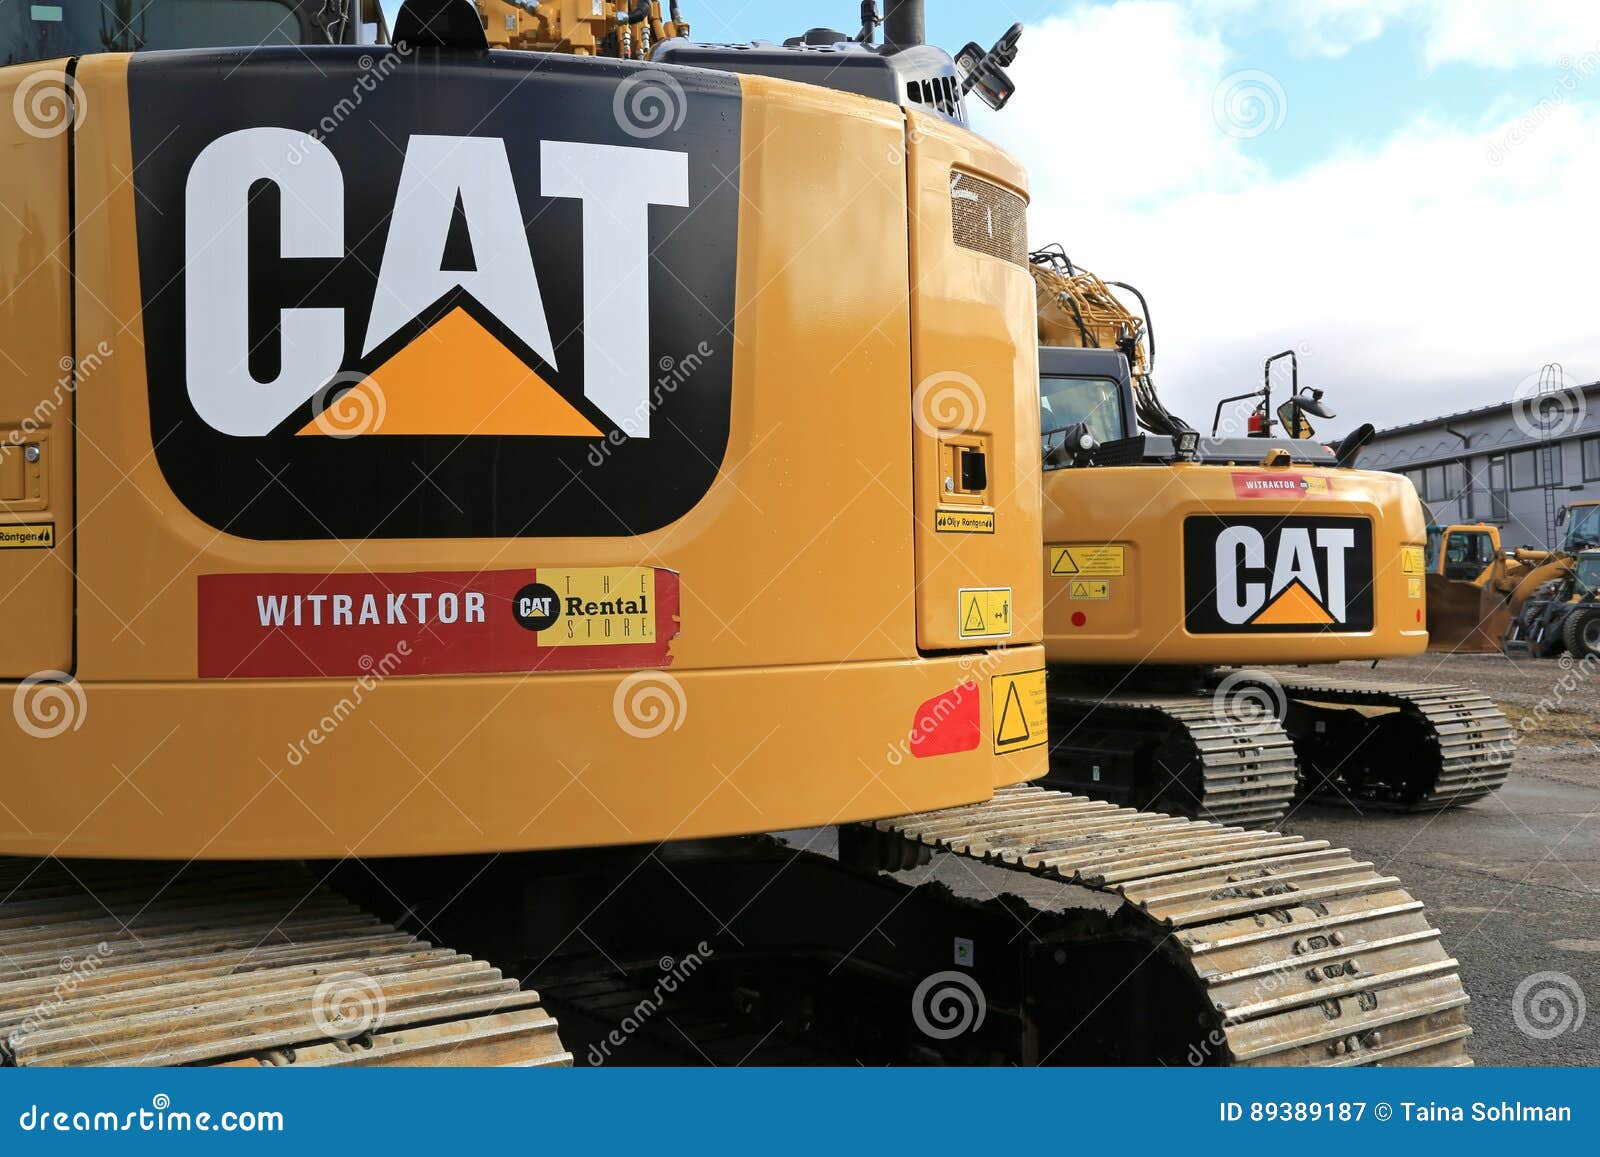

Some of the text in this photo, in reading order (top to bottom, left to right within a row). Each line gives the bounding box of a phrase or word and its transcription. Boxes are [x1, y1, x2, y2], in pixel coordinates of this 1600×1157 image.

[185, 126, 689, 439] CAT
[1246, 480, 1295, 489] WITRAKTOR
[565, 575, 646, 595] THE
[1215, 525, 1354, 625] CAT
[256, 592, 486, 626] WITRAKTOR
[519, 597, 552, 618] CAT
[565, 595, 648, 616] Rental
